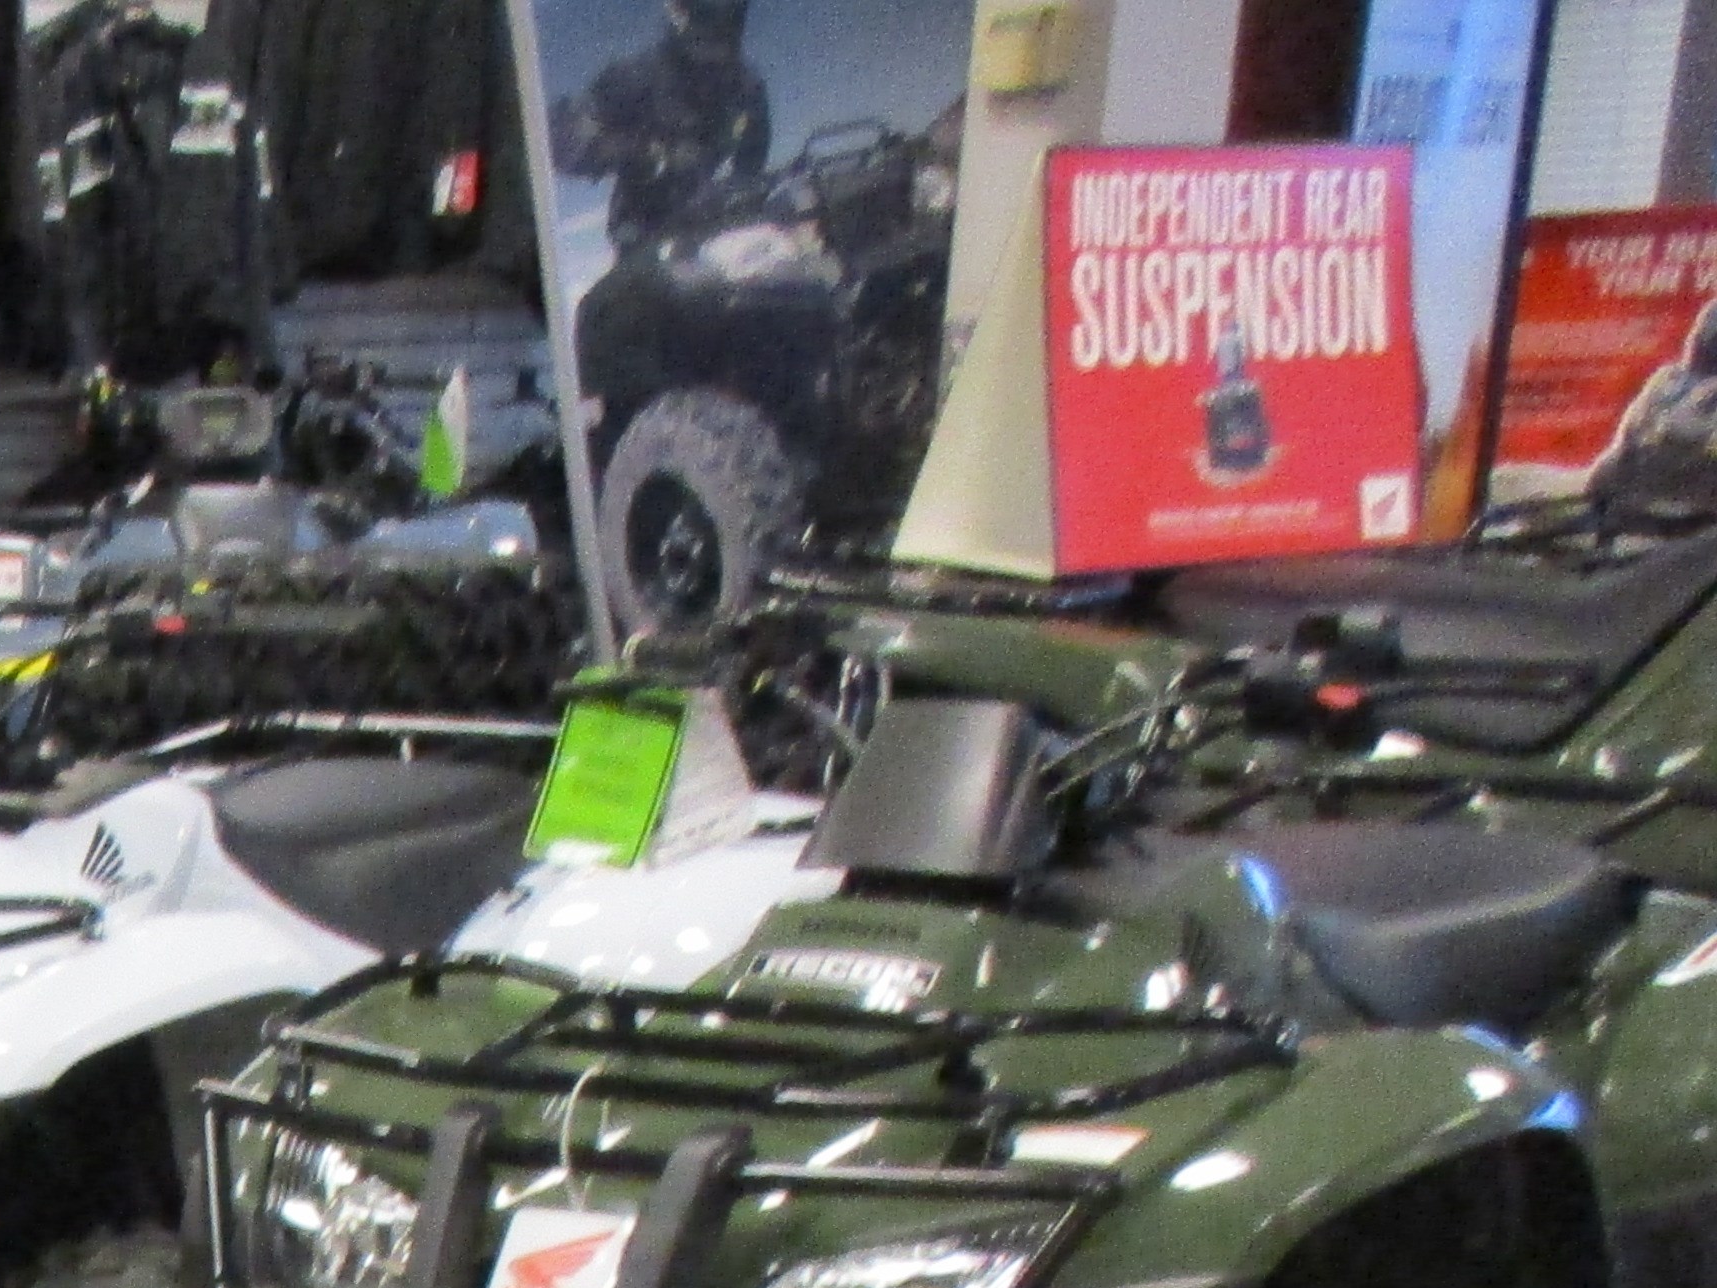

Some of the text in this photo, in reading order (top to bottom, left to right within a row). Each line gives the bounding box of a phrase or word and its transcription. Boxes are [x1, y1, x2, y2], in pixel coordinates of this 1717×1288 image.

[1070, 166, 1389, 252] INDEPENDENT REAR
[1070, 245, 1390, 369] SUSPENSION
